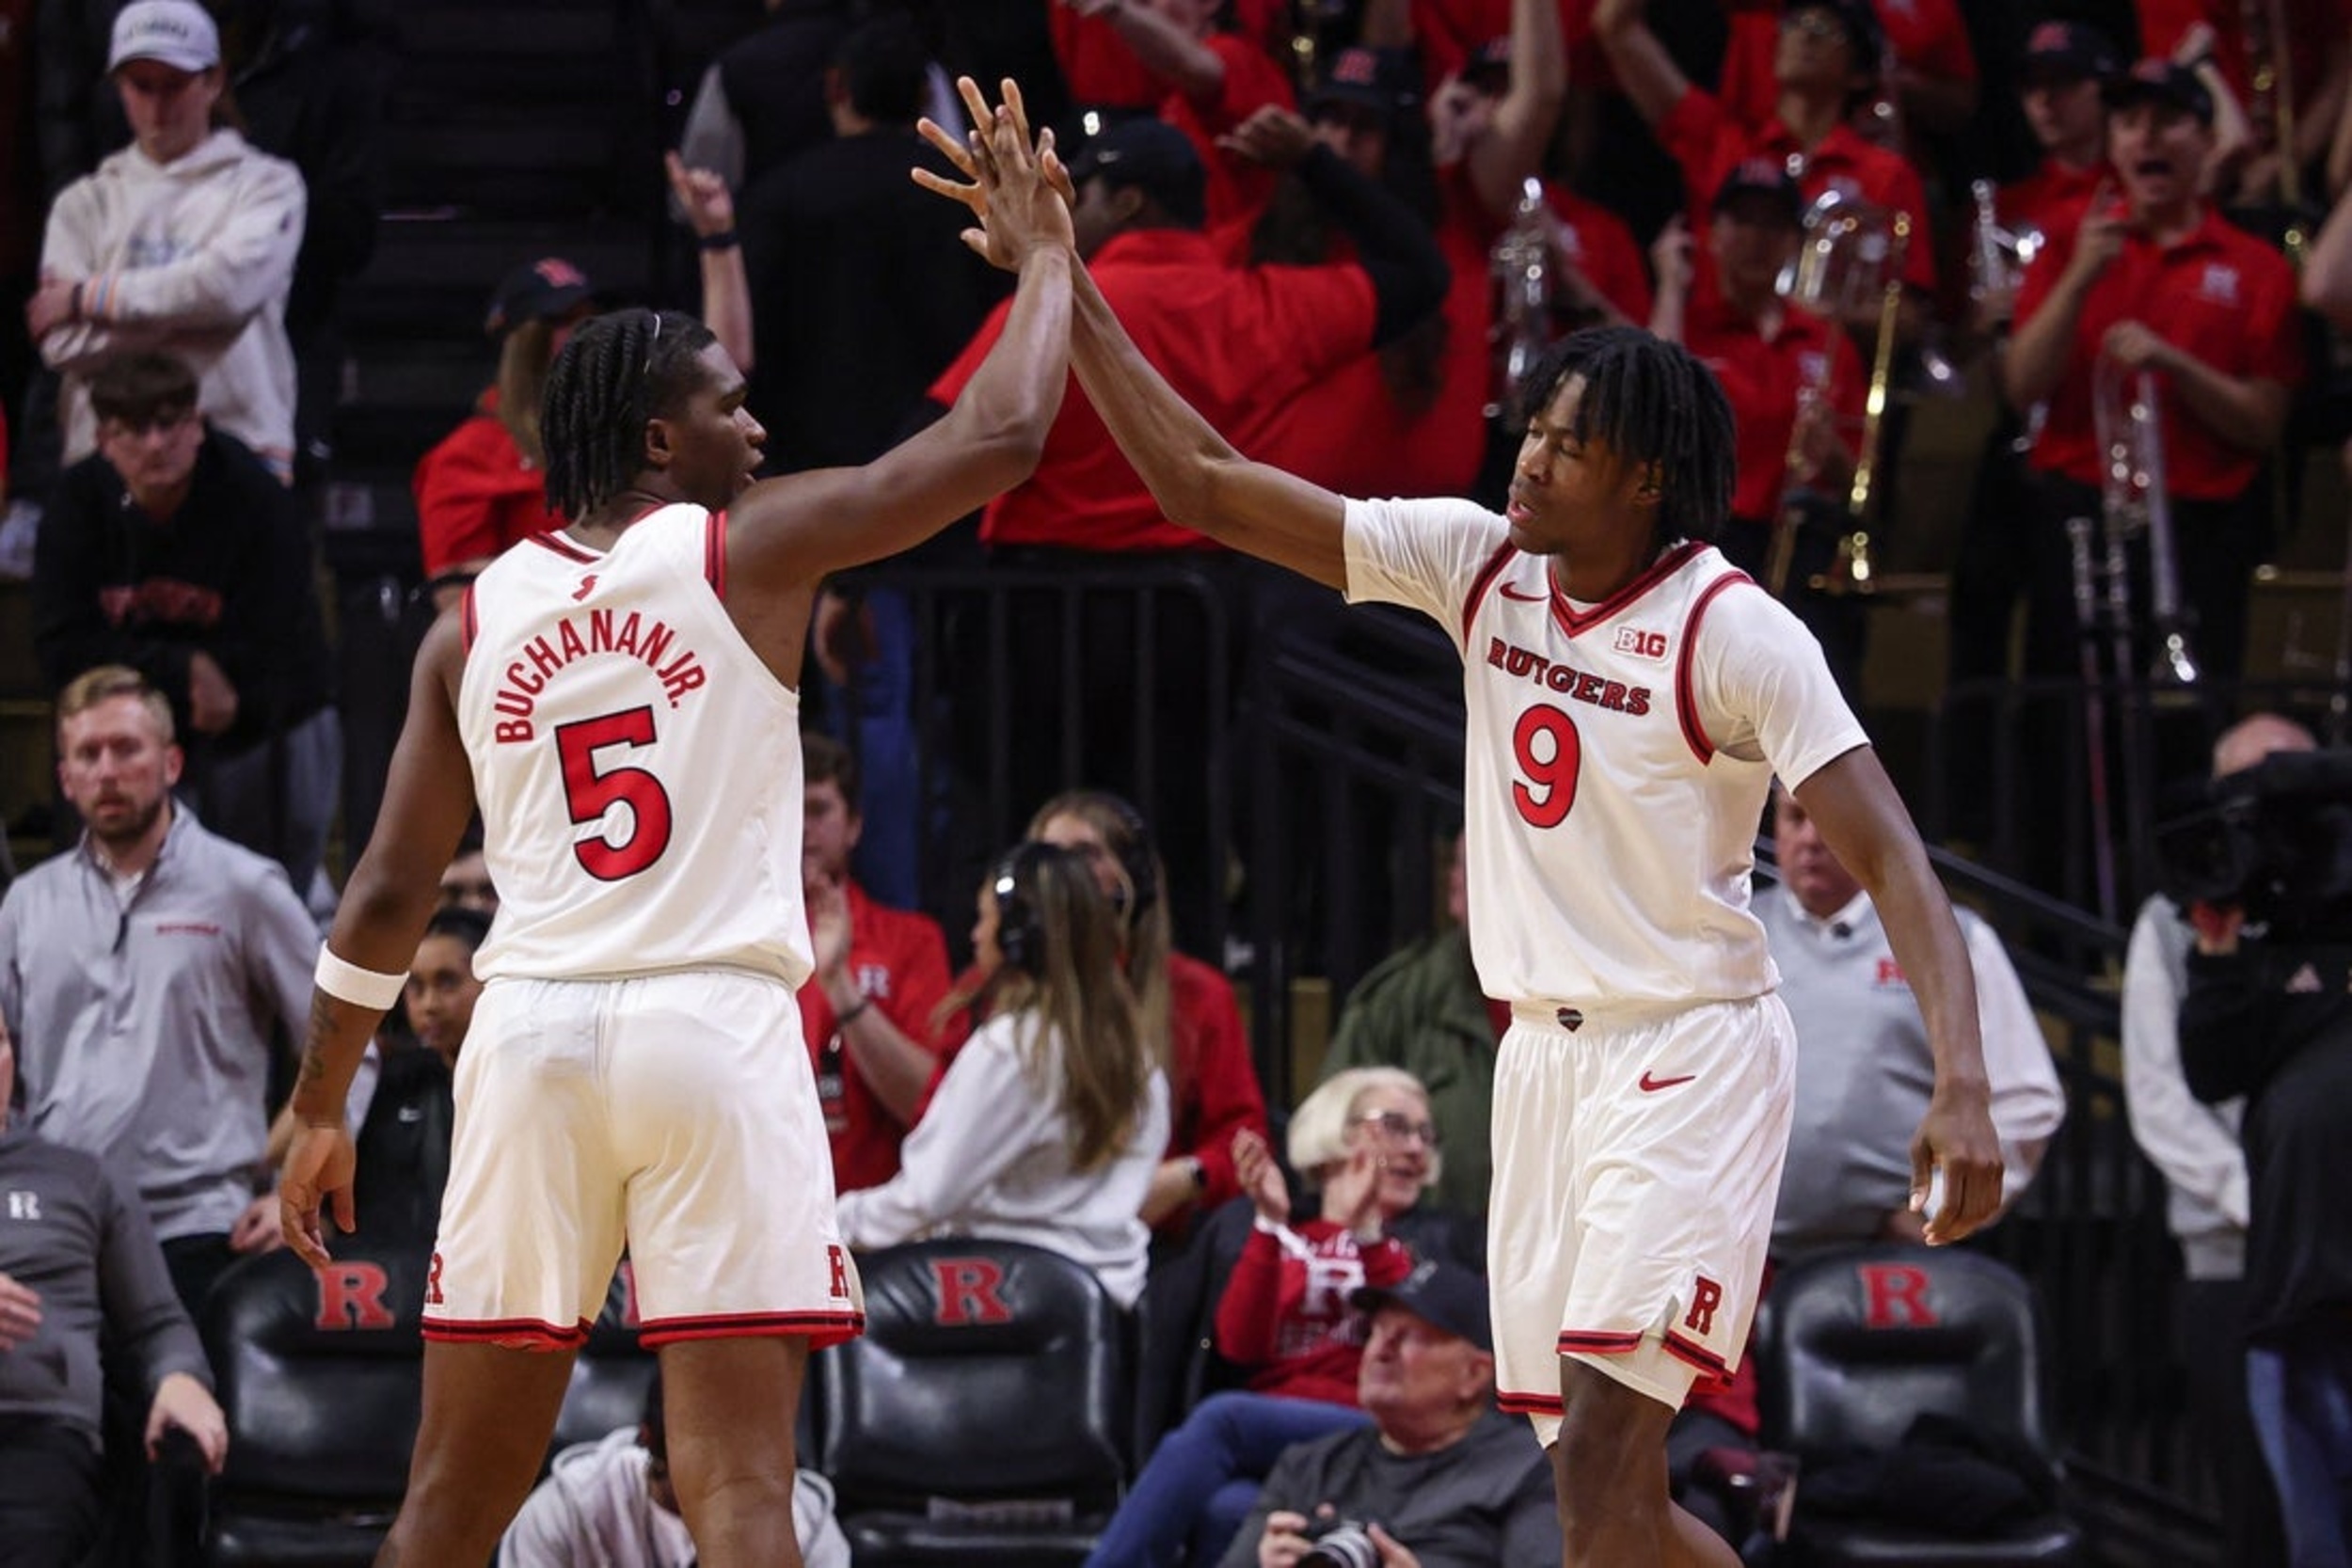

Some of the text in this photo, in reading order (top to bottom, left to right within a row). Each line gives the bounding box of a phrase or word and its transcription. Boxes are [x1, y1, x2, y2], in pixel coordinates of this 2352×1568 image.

[494, 609, 707, 743] BUCHANAN JR.
[1486, 636, 1652, 717] RUTGERS
[555, 705, 673, 882] 5
[1512, 703, 1582, 830] 9
[8, 1190, 41, 1220] R
[313, 1259, 396, 1331] R
[928, 1256, 1013, 1325] R
[1684, 1275, 1723, 1337] R
[1857, 1261, 1942, 1329] R
